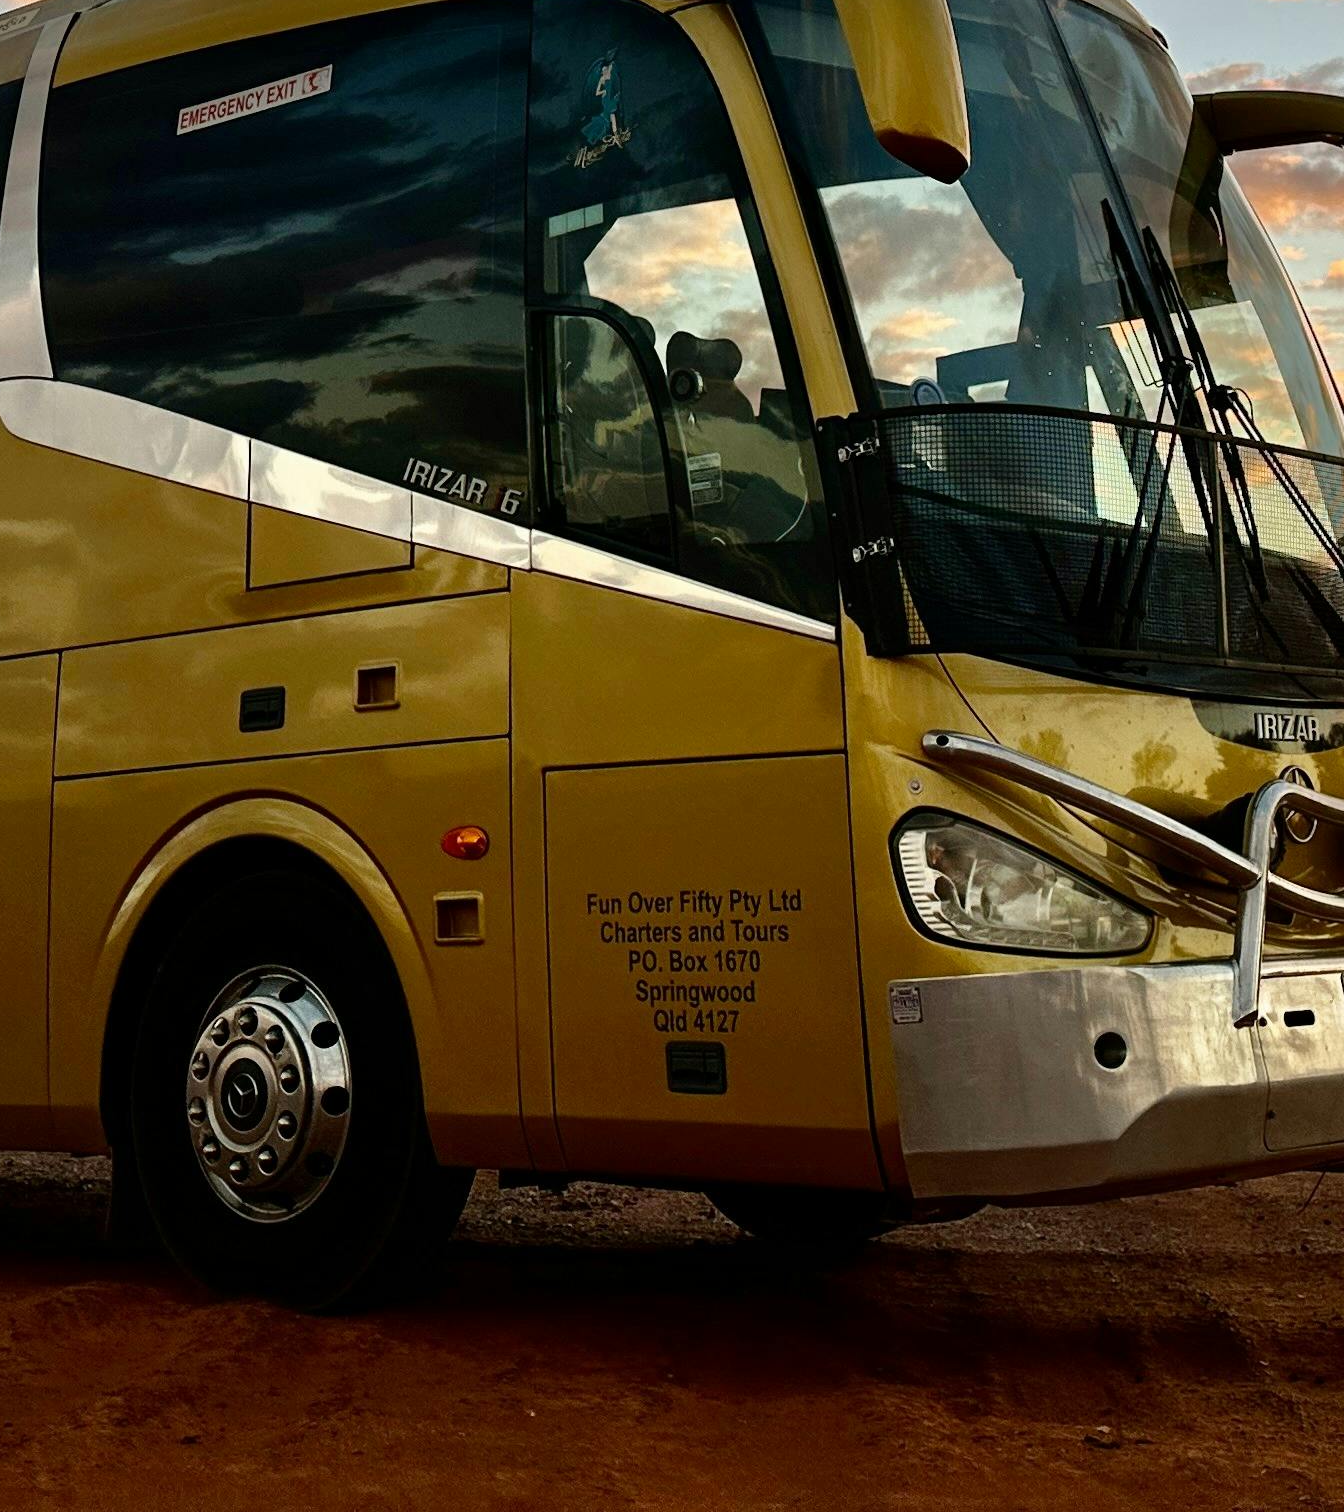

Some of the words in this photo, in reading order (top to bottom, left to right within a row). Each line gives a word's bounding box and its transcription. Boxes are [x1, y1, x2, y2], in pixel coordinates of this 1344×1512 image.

[180, 91, 264, 129] EMERGENCY
[266, 80, 297, 104] EXIT
[402, 457, 488, 504] IRIZAR
[1257, 714, 1321, 741] IRIZAR
[587, 893, 622, 915] Fun
[628, 891, 674, 914] Over
[680, 890, 724, 918] Fifty
[729, 889, 762, 918] Pty
[769, 889, 802, 912] Ltd
[600, 921, 682, 944] Charters
[688, 920, 725, 942] and
[730, 919, 790, 942] Tours
[628, 949, 663, 973] PO.
[669, 949, 708, 972] Box
[714, 949, 761, 972] 1670
[635, 979, 756, 1008] Springwood
[653, 1009, 687, 1032] Qld
[693, 1009, 739, 1033] 4127
